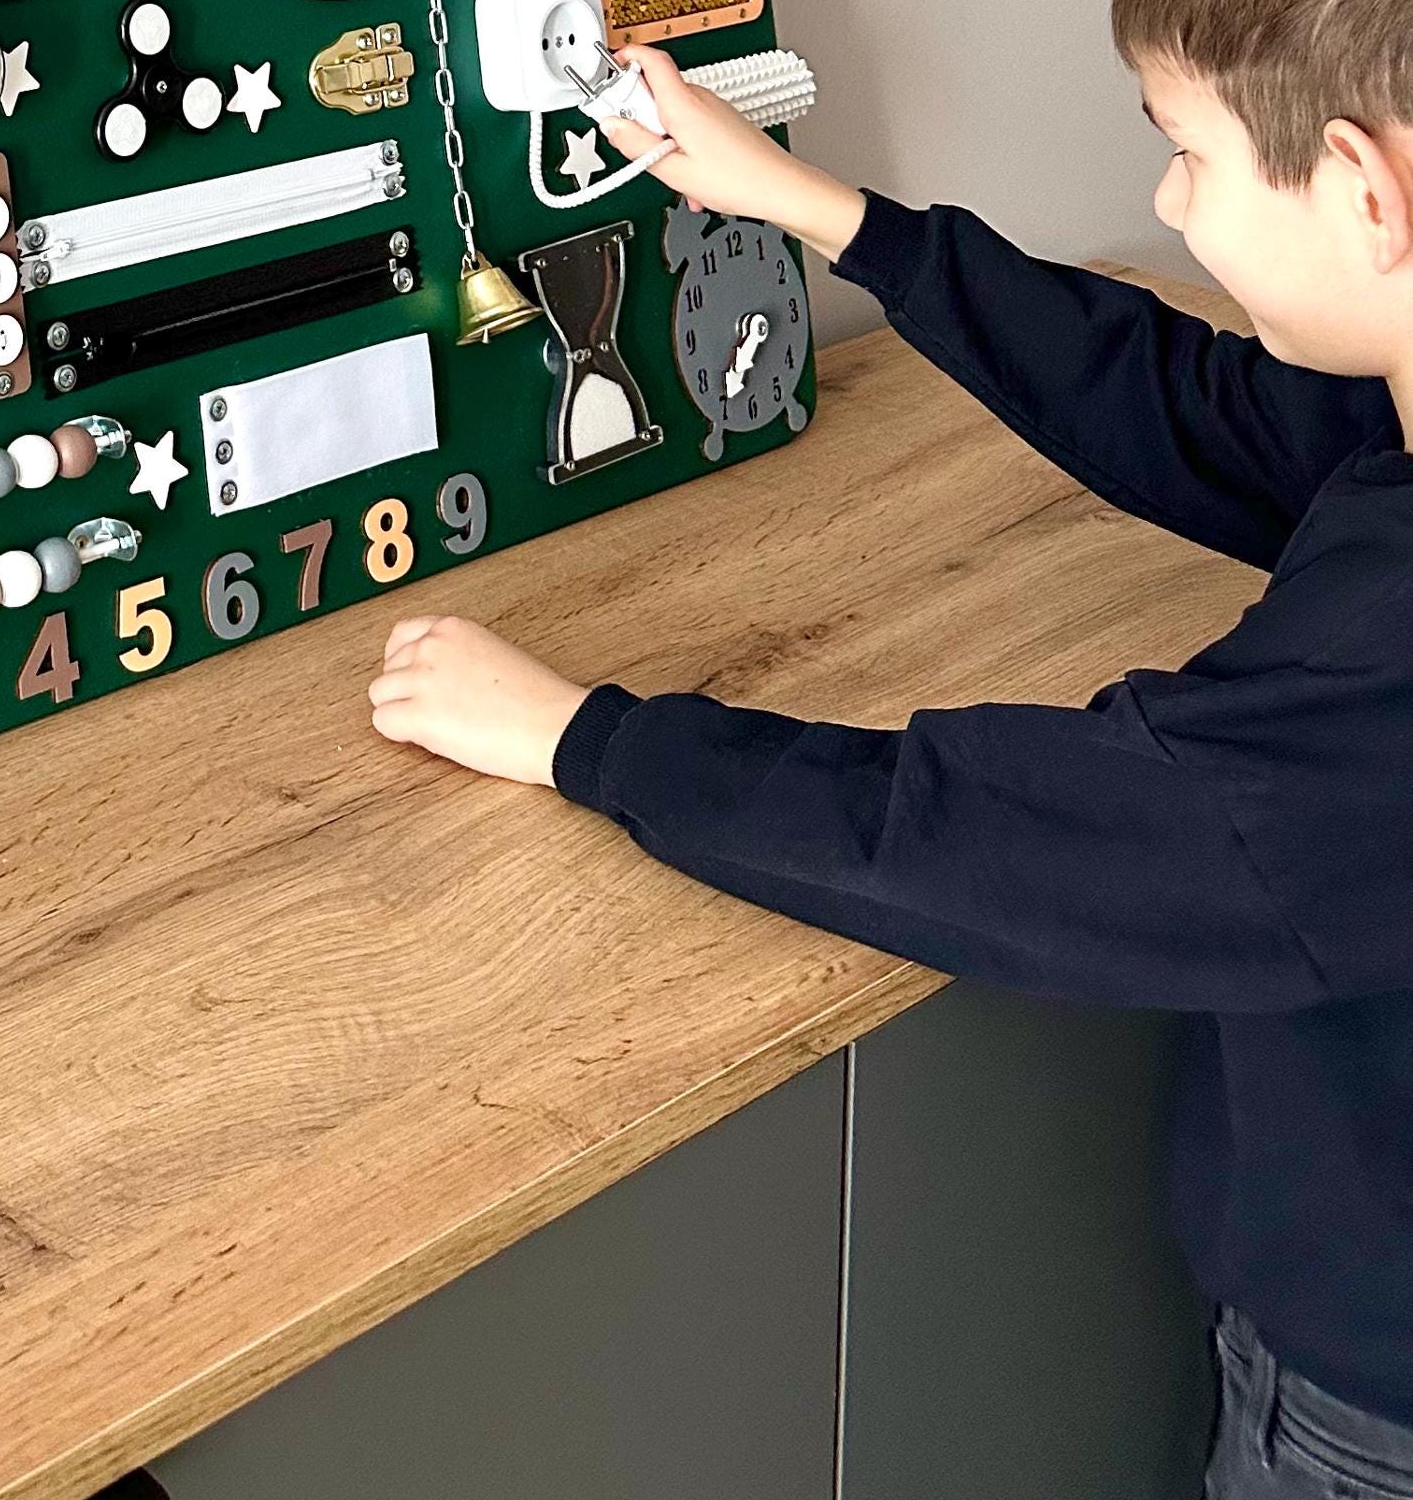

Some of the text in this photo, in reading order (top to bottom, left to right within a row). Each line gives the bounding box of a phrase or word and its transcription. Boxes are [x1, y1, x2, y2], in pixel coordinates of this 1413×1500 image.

[725, 230, 743, 258] 12
[756, 235, 765, 260] 1
[701, 248, 718, 276] 11
[776, 259, 786, 284] 2
[685, 284, 703, 313] 10
[789, 298, 799, 323] 3
[686, 328, 696, 355] 9
[785, 344, 794, 369] 4
[698, 368, 709, 394] 8
[772, 376, 782, 402] 5
[719, 396, 729, 420] 7
[748, 394, 758, 420] 6
[18, 611, 80, 703] 4
[115, 576, 173, 672] 5
[202, 552, 260, 640] 6
[280, 519, 333, 611] 7
[362, 498, 414, 583] 8
[436, 473, 487, 555] 9
